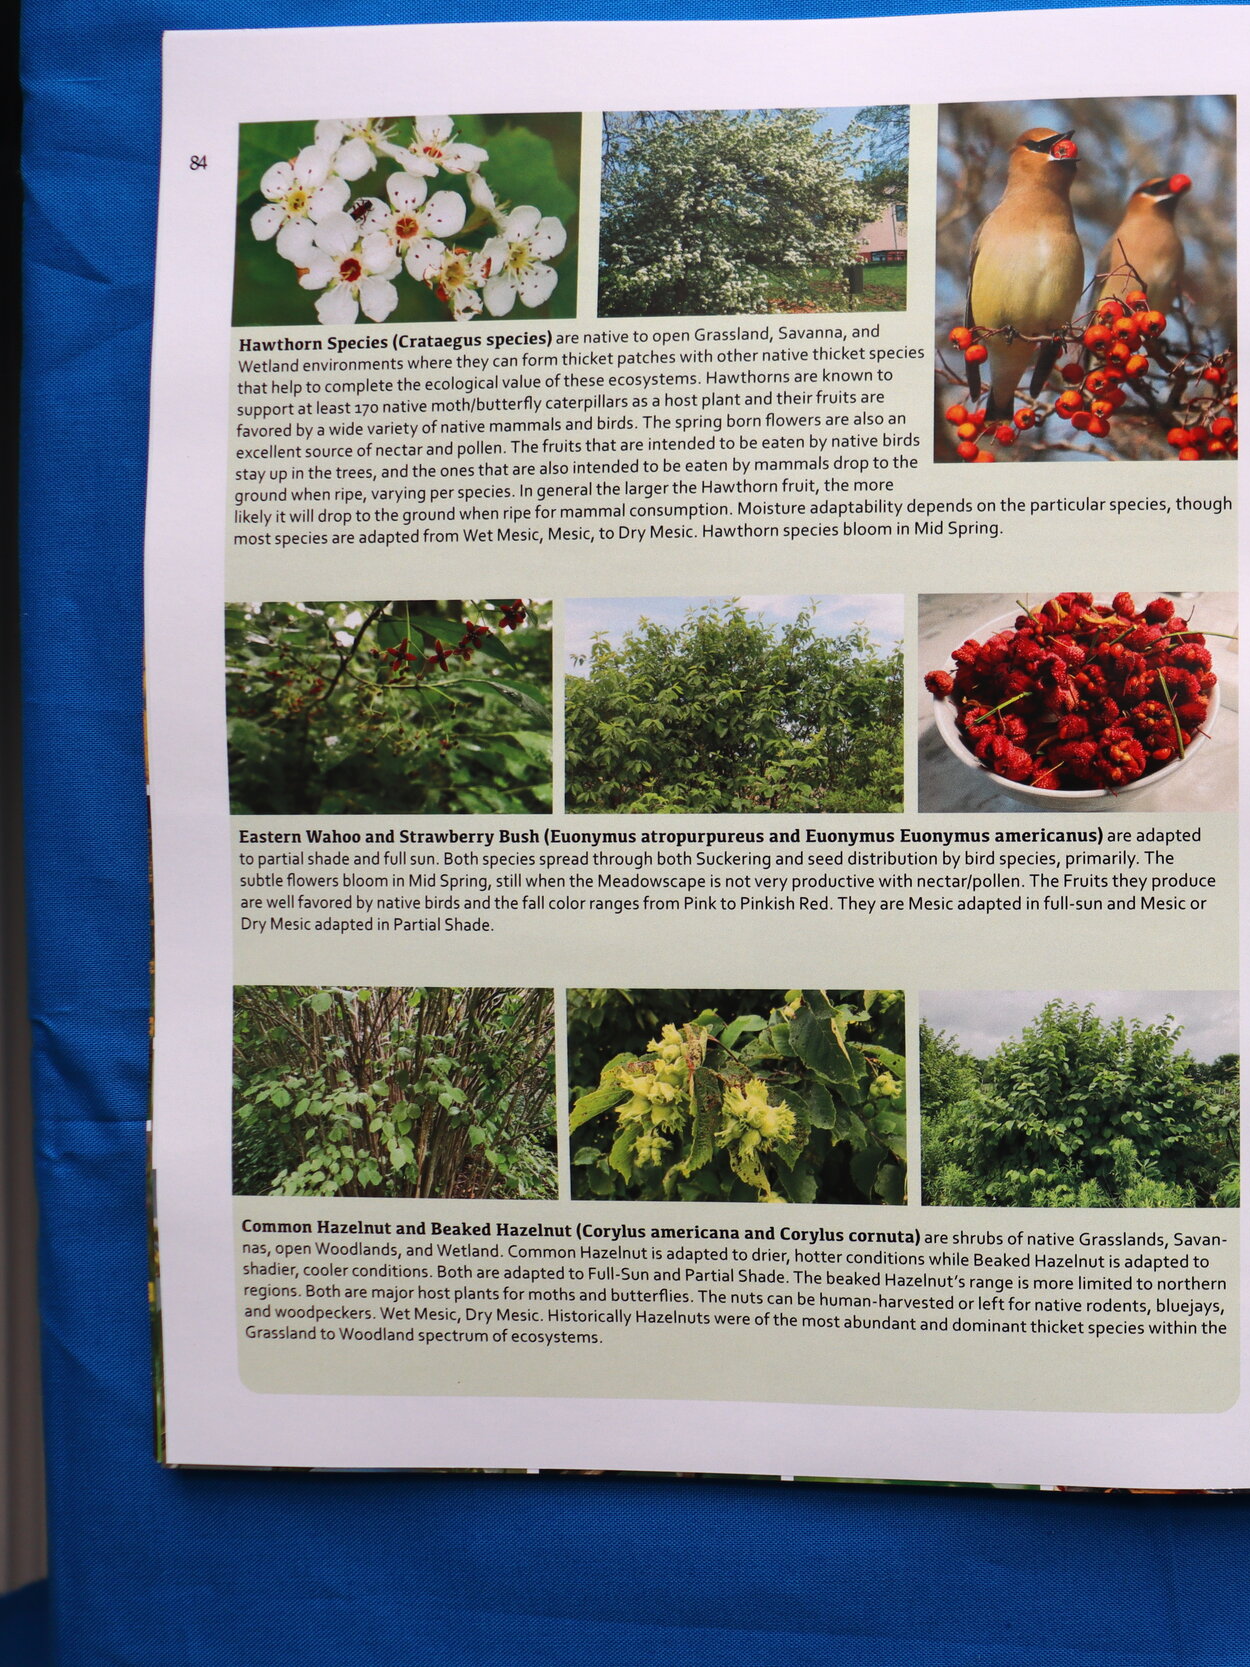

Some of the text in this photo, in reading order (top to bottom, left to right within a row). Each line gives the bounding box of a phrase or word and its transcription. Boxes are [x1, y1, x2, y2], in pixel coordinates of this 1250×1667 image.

[189, 154, 208, 171] 84
[238, 322, 881, 355] Hawthorn Species (Crataegus species) are native to open Grassland, Savanna, and
[233, 519, 1004, 550] most species are adapted from Wet Mesic, Mesic, to Dry Mesic. Hawthorn species bloom in Mid Spring.
[238, 825, 1202, 848] Eastern Wahoo and Strawberry Bush (Euonymus atropurpureus and Euonymus Euonymus americanus) are adapted
[240, 915, 495, 936] Dry Mesic adapted in Partial Shade.
[240, 1218, 1228, 1251] Common Hazelnut and Beaked Hazelnut (Corylus americana and Corylus cornuta) are shrubs of native Grasslands, Savan-
[244, 1324, 604, 1348] Grassland to Woodland spectrum of ecosystems.
